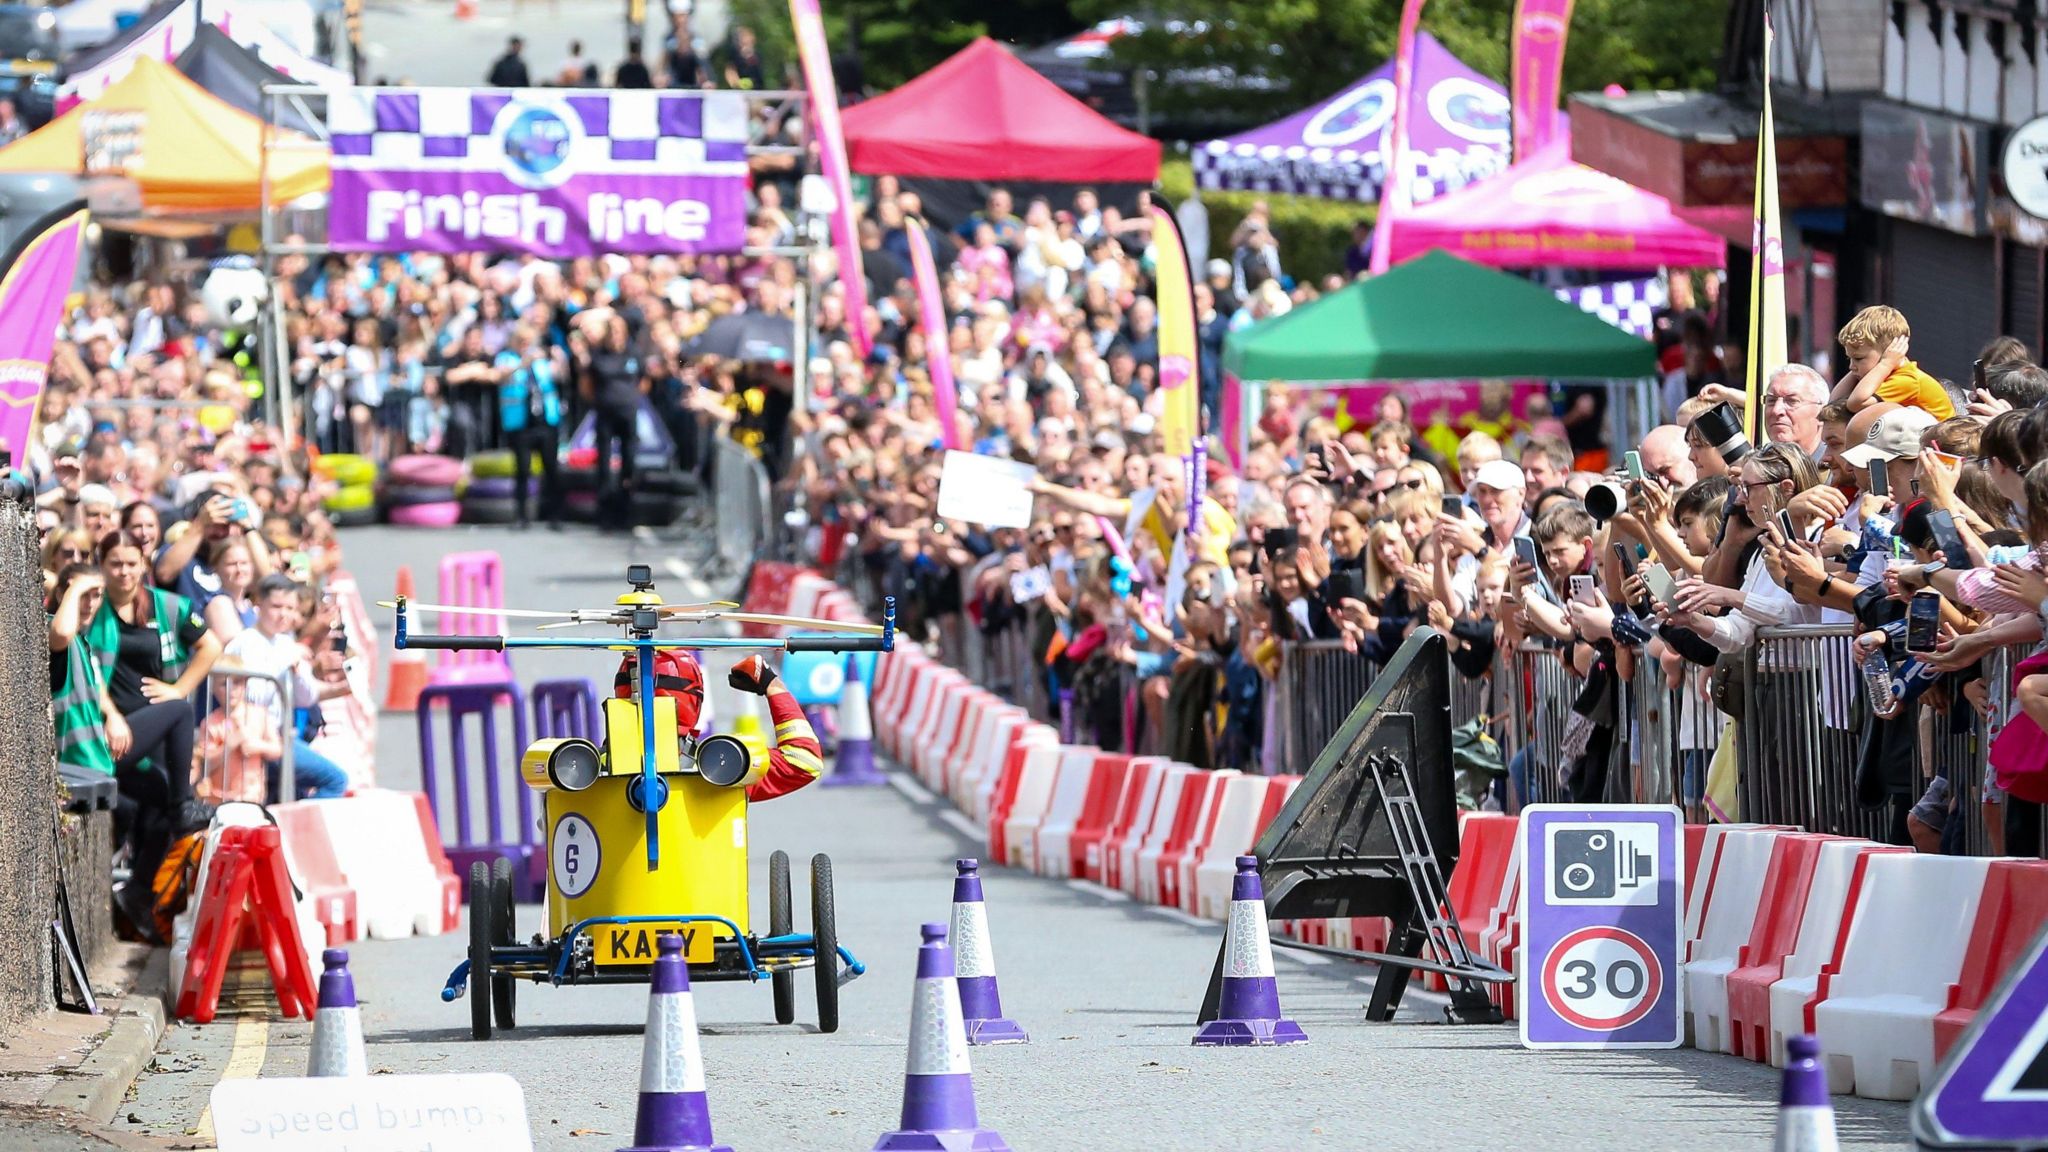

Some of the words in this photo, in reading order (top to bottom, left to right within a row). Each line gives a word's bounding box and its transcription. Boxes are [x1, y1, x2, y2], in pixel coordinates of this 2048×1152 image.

[366, 190, 567, 245] Finish
[588, 192, 711, 242] line
[565, 844, 579, 874] 6
[1563, 960, 1644, 999] 30
[376, 1101, 508, 1132] bump
